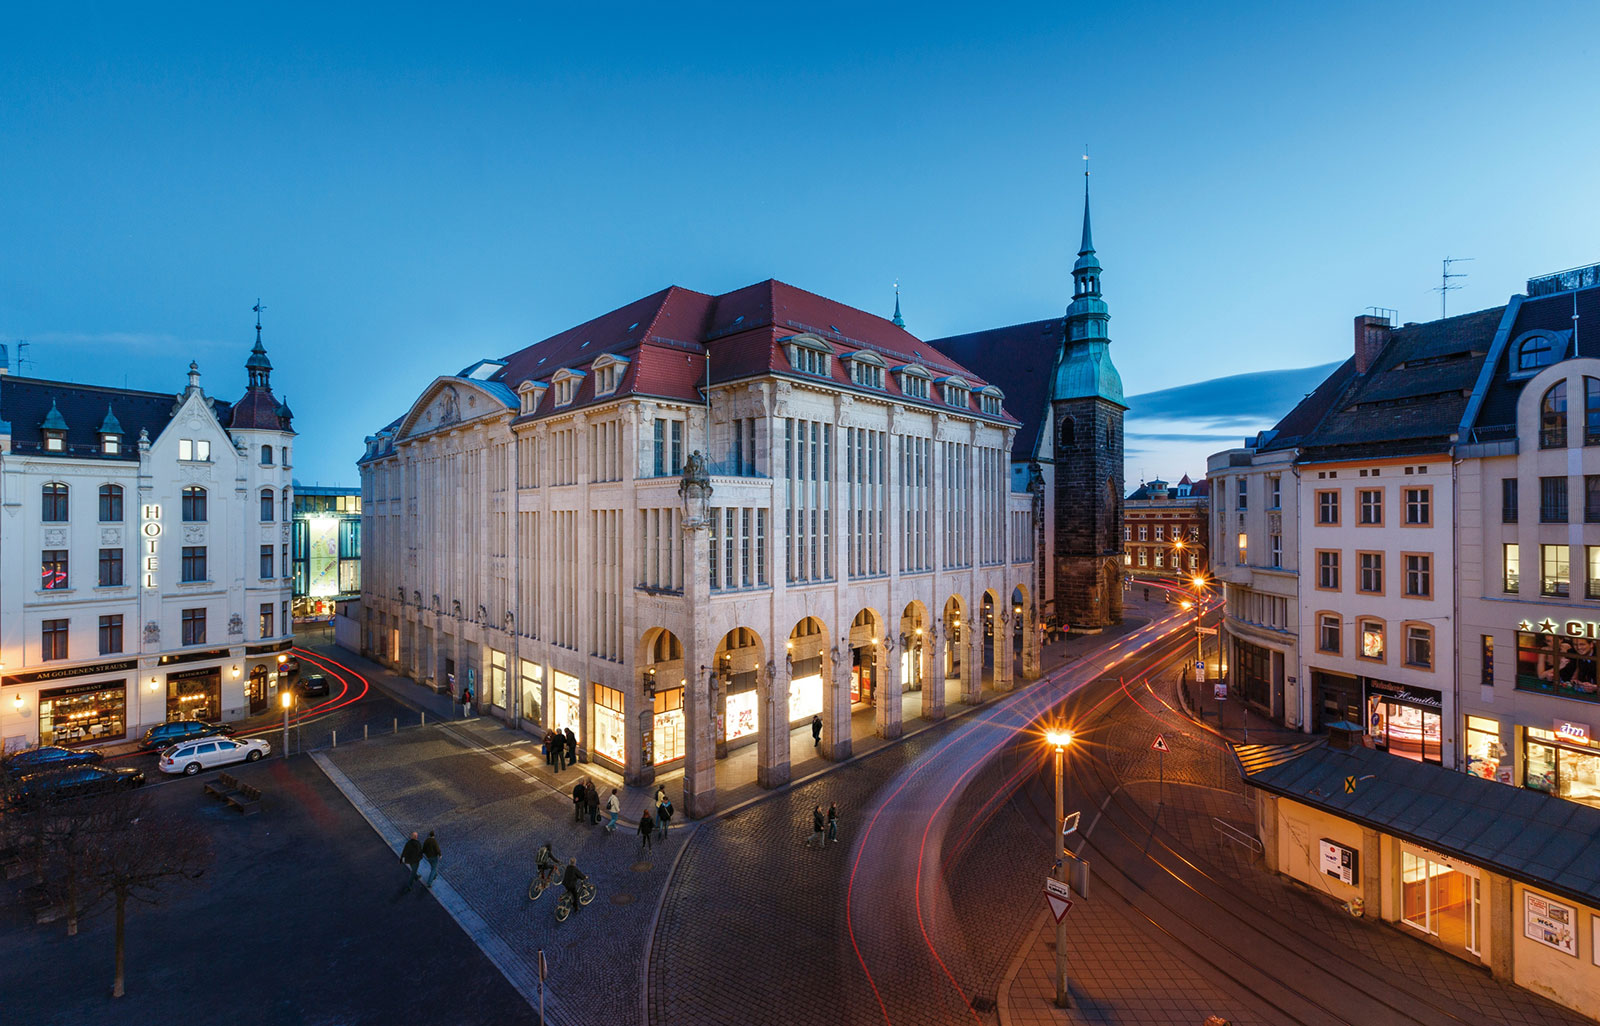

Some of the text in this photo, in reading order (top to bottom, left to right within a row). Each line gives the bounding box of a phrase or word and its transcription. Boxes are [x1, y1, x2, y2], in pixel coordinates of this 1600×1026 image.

[143, 504, 161, 589] HOTEL
[1566, 621, 1600, 638] CI
[36, 662, 128, 680] AM GOLDENEN STRAUSS
[1560, 722, 1584, 738] dm
